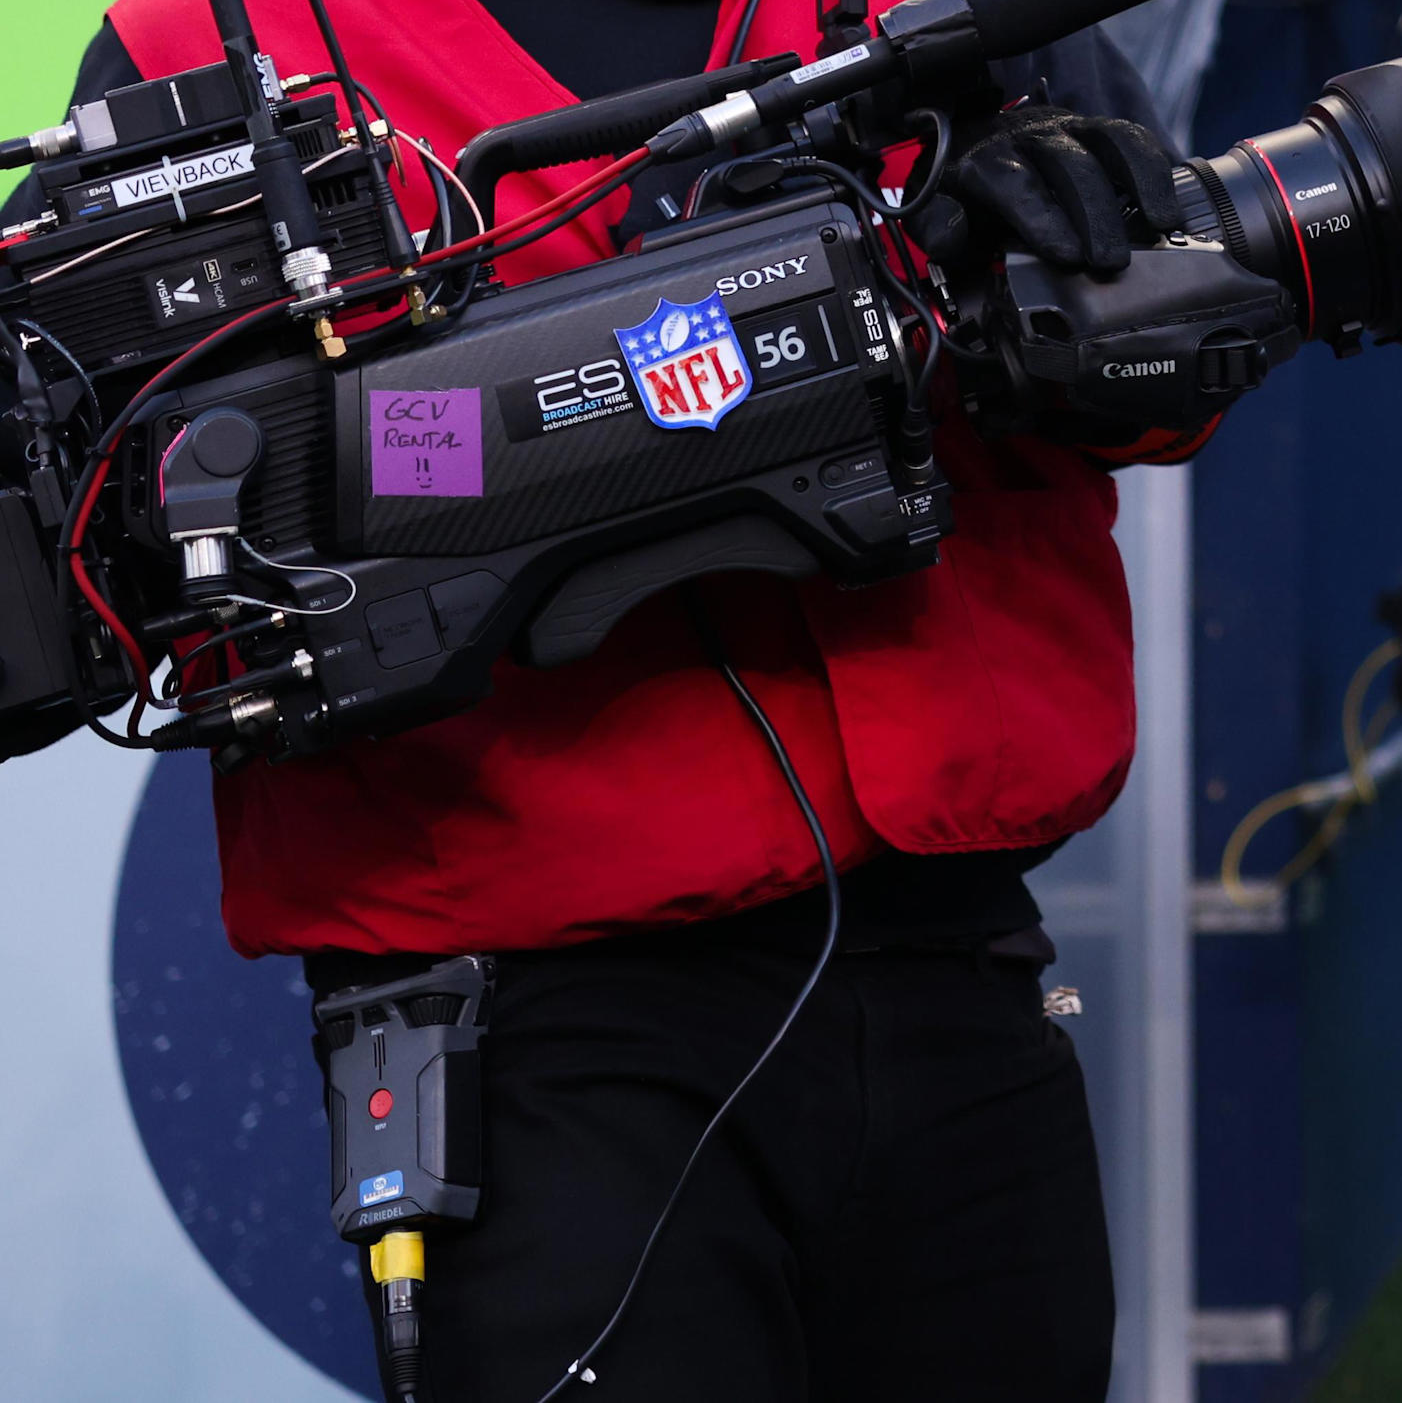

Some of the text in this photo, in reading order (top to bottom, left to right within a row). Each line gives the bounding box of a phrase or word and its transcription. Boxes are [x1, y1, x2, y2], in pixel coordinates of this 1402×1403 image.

[126, 151, 244, 199] VIEWBACK
[88, 184, 111, 198] EMG
[1294, 182, 1338, 201] Canon
[1305, 213, 1351, 239] 17-120
[206, 262, 227, 309] 4K HCAM
[240, 275, 259, 287] USB
[715, 255, 809, 297] SONY
[155, 278, 176, 319] vislink
[753, 325, 806, 369] 56
[644, 346, 745, 417] NFL
[1102, 359, 1176, 380] Canon
[533, 358, 627, 413] ES
[542, 392, 630, 422] BROADCAST HIRE
[542, 401, 635, 432] esbroadcasthire.com
[383, 428, 463, 450] RENTAL
[373, 1205, 405, 1223] RIEDEL
